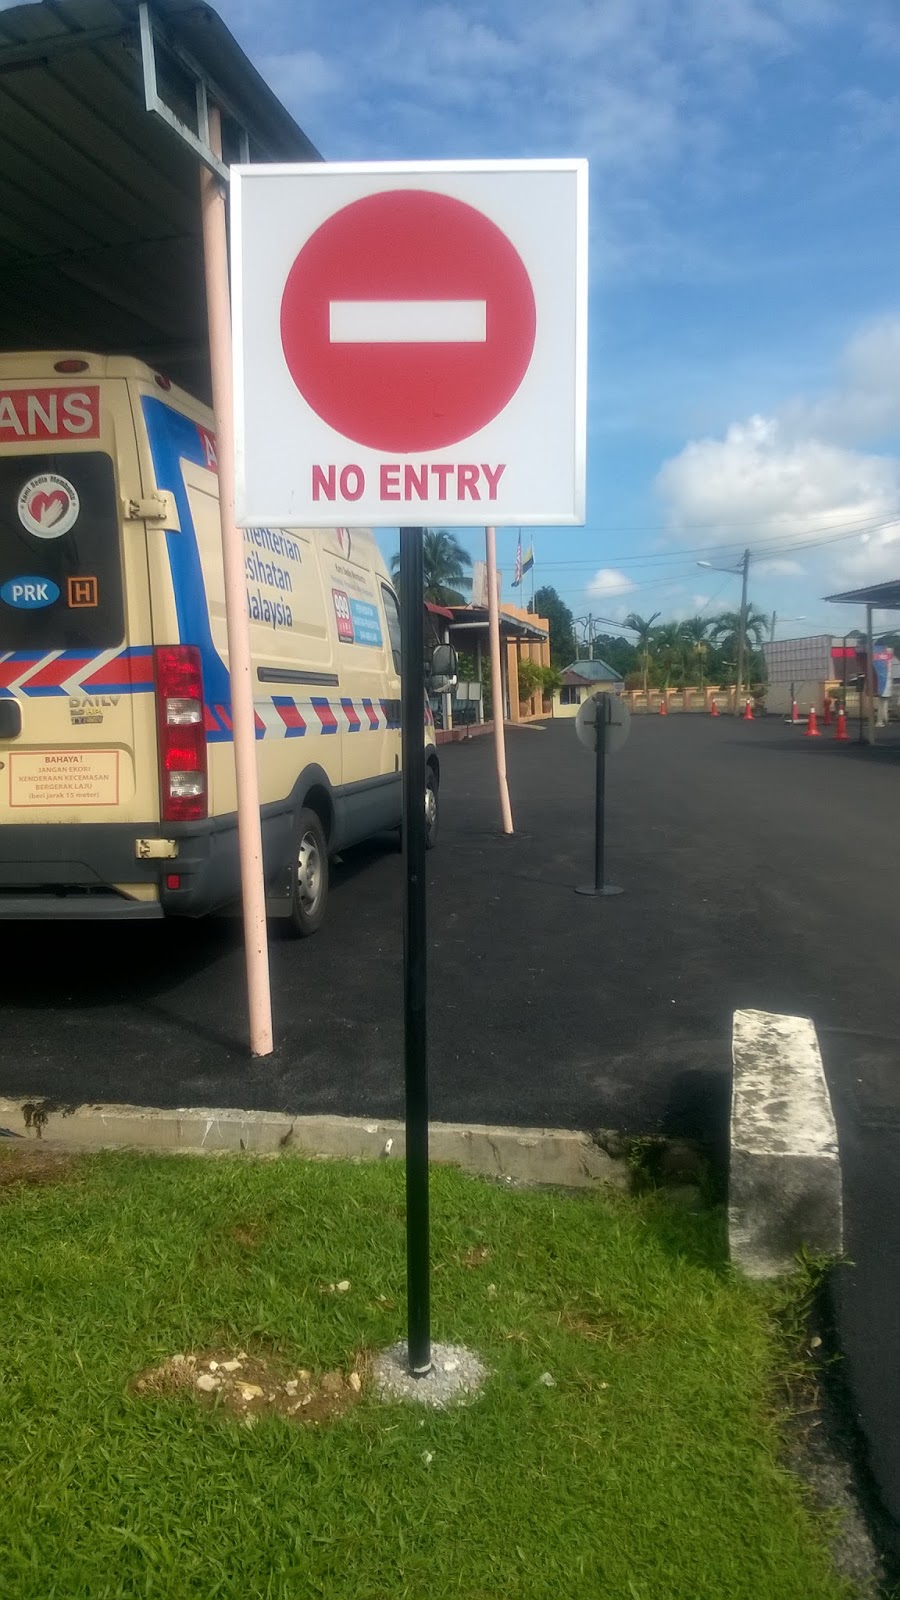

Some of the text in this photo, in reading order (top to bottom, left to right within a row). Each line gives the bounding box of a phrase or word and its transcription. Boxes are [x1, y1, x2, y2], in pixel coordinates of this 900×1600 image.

[0, 393, 93, 436] ANS
[312, 464, 507, 502] NO ENTRY
[245, 551, 293, 592] sihatan
[12, 583, 49, 602] PRK
[75, 582, 91, 602] H
[334, 594, 350, 620] 999
[246, 588, 293, 630] alaysia
[46, 792, 65, 800] jarak
